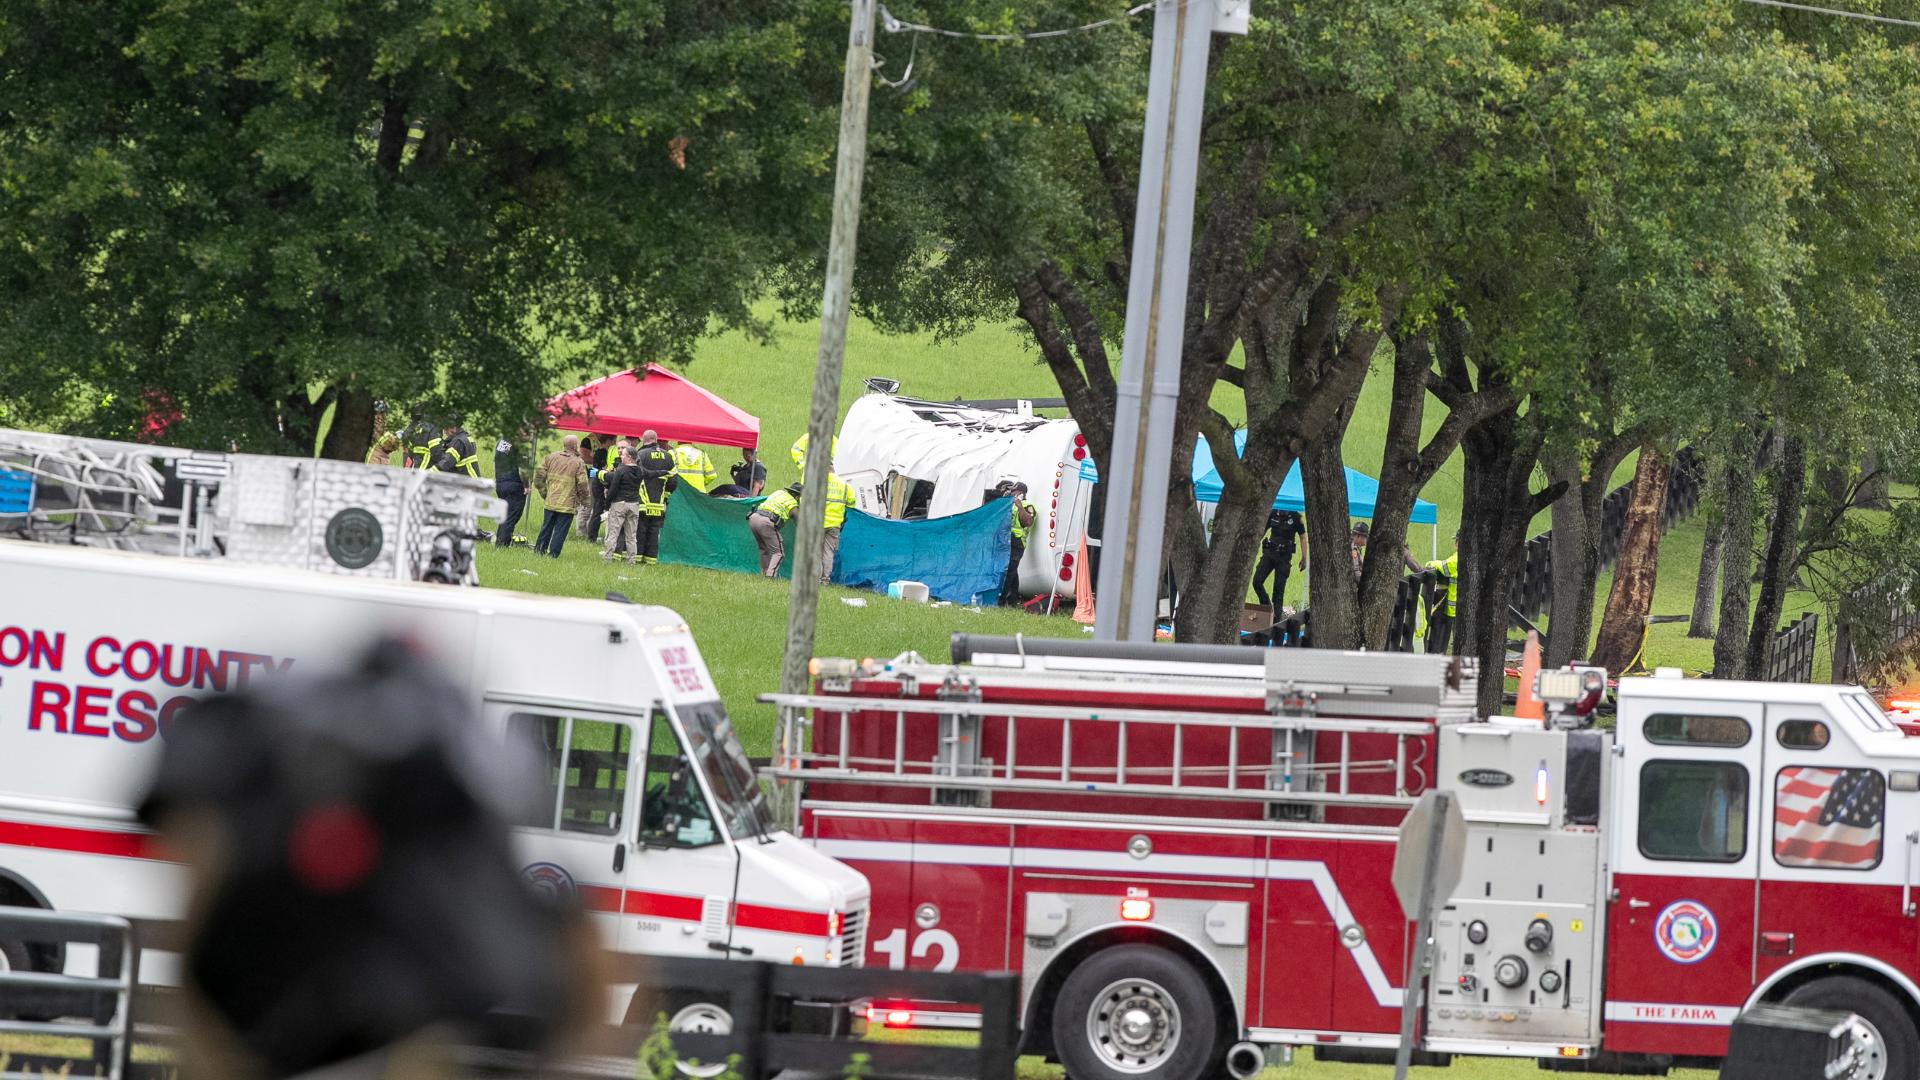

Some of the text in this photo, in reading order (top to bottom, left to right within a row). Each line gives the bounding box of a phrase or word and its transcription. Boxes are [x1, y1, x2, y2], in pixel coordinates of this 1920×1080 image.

[873, 928, 960, 973] 12
[1632, 1006, 1717, 1020] THE FARM
